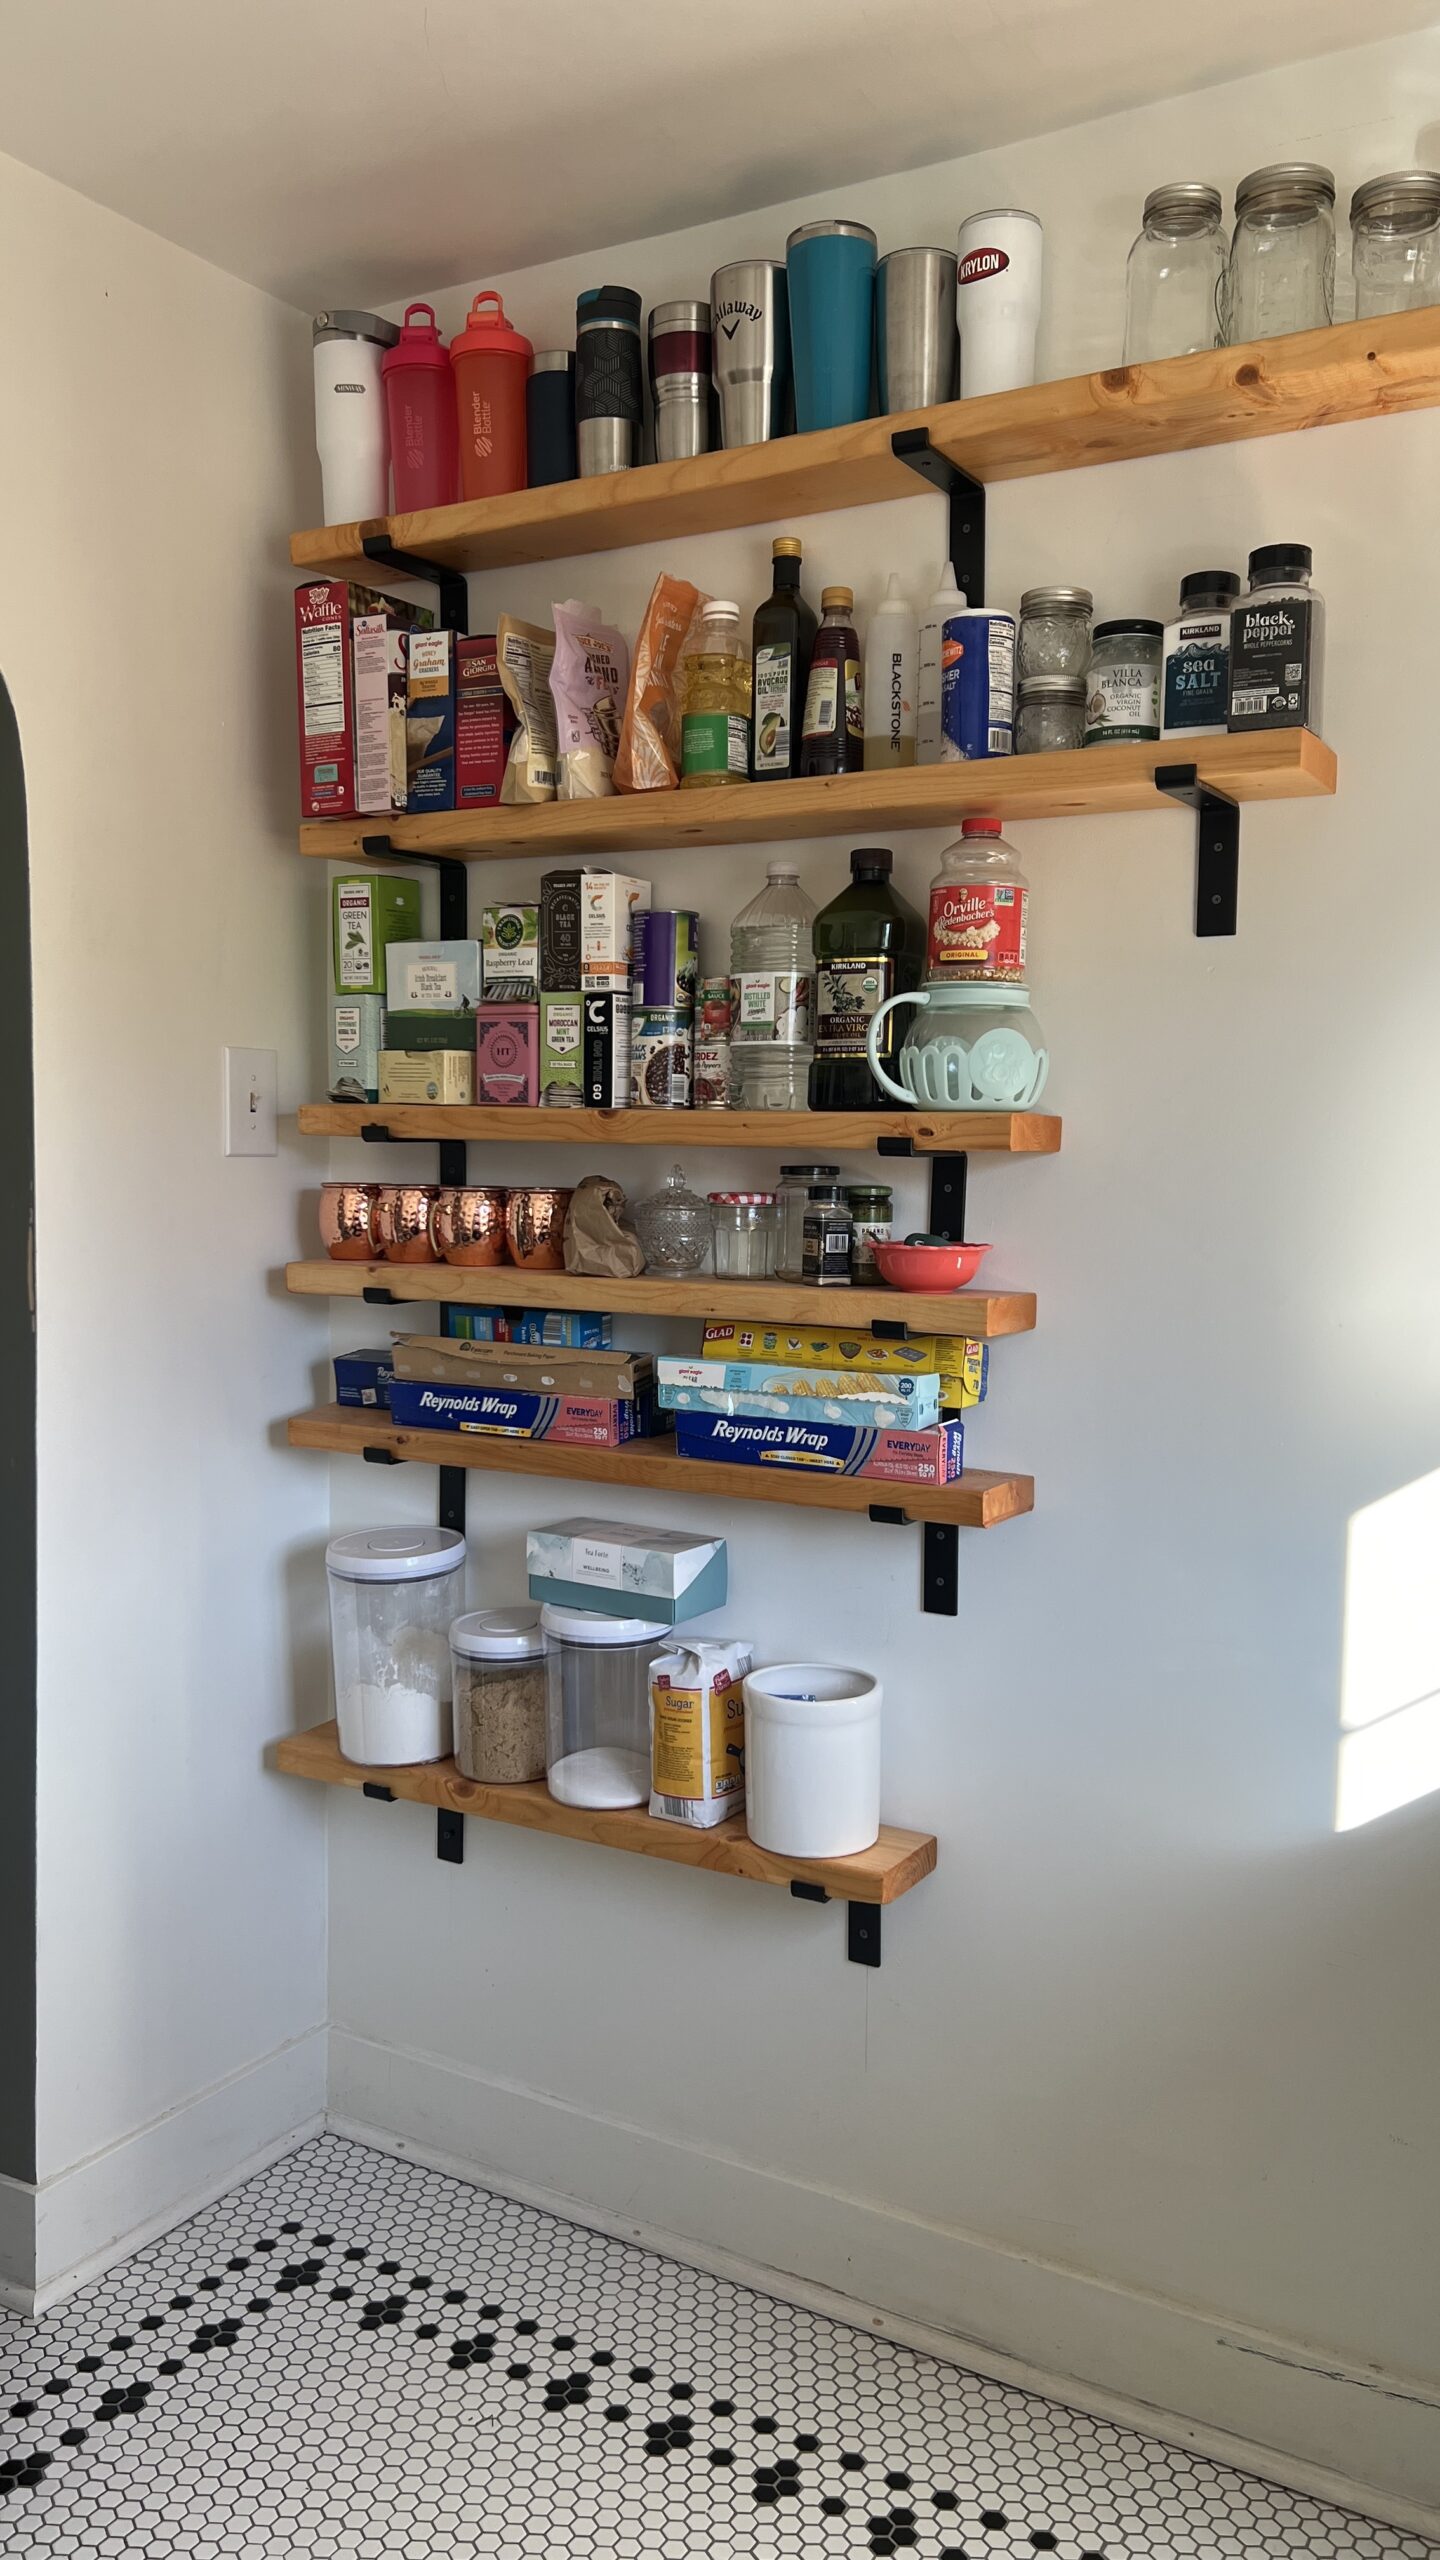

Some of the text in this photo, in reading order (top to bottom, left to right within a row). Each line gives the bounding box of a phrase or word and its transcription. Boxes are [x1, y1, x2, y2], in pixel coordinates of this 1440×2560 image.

[959, 254, 1000, 280] KRYLON
[716, 301, 763, 325] allaway
[472, 391, 481, 435] Blender
[482, 401, 492, 434] Bottle
[405, 405, 413, 447] Blender
[414, 415, 424, 446] Bottle
[300, 602, 342, 623] Waffle
[1245, 611, 1293, 628] black
[325, 624, 341, 632] Facts
[1181, 626, 1220, 636] KIRKLAND
[1243, 624, 1296, 642] pepper
[413, 658, 445, 671] Graham
[471, 659, 486, 667] SAN
[1182, 659, 1215, 673] sea
[462, 664, 496, 677] GIORGIO
[943, 669, 960, 681] SHER
[1113, 669, 1142, 678] VILLA
[757, 676, 788, 686] AVOCADO
[1101, 678, 1142, 688] BLANCA
[1175, 672, 1221, 690] SALT
[757, 686, 769, 695] OIL
[891, 653, 902, 752] BLACKSTONE
[585, 881, 593, 890] 14
[943, 897, 986, 917] Orville
[342, 911, 367, 920] GREEN
[556, 913, 575, 921] BLACK
[938, 908, 995, 929] Redenbacher's
[347, 921, 362, 930] TEA
[485, 958, 534, 969] Raspberry Leaf
[831, 963, 867, 971] KIRKLAND
[744, 992, 770, 1000] DISTILLED
[748, 1000, 767, 1008] WHITE
[650, 1014, 675, 1022] ORGANIC
[830, 1016, 865, 1024] ORGANIC
[586, 1026, 609, 1034] CELSIUS
[818, 1023, 869, 1033] EXTRA VIRG
[497, 1048, 509, 1056] HT
[593, 1083, 602, 1100] GO
[705, 1327, 734, 1339] GLAD
[966, 1344, 979, 1355] GLAD
[420, 1391, 518, 1419] Reynolds Wrap
[566, 1407, 603, 1417] EVERYDAY
[593, 1427, 608, 1436] 250
[711, 1419, 829, 1451] Reynolds Wrap
[887, 1440, 931, 1453] EVERYDAY
[918, 1463, 936, 1473] 250
[665, 1695, 694, 1710] Sugar
